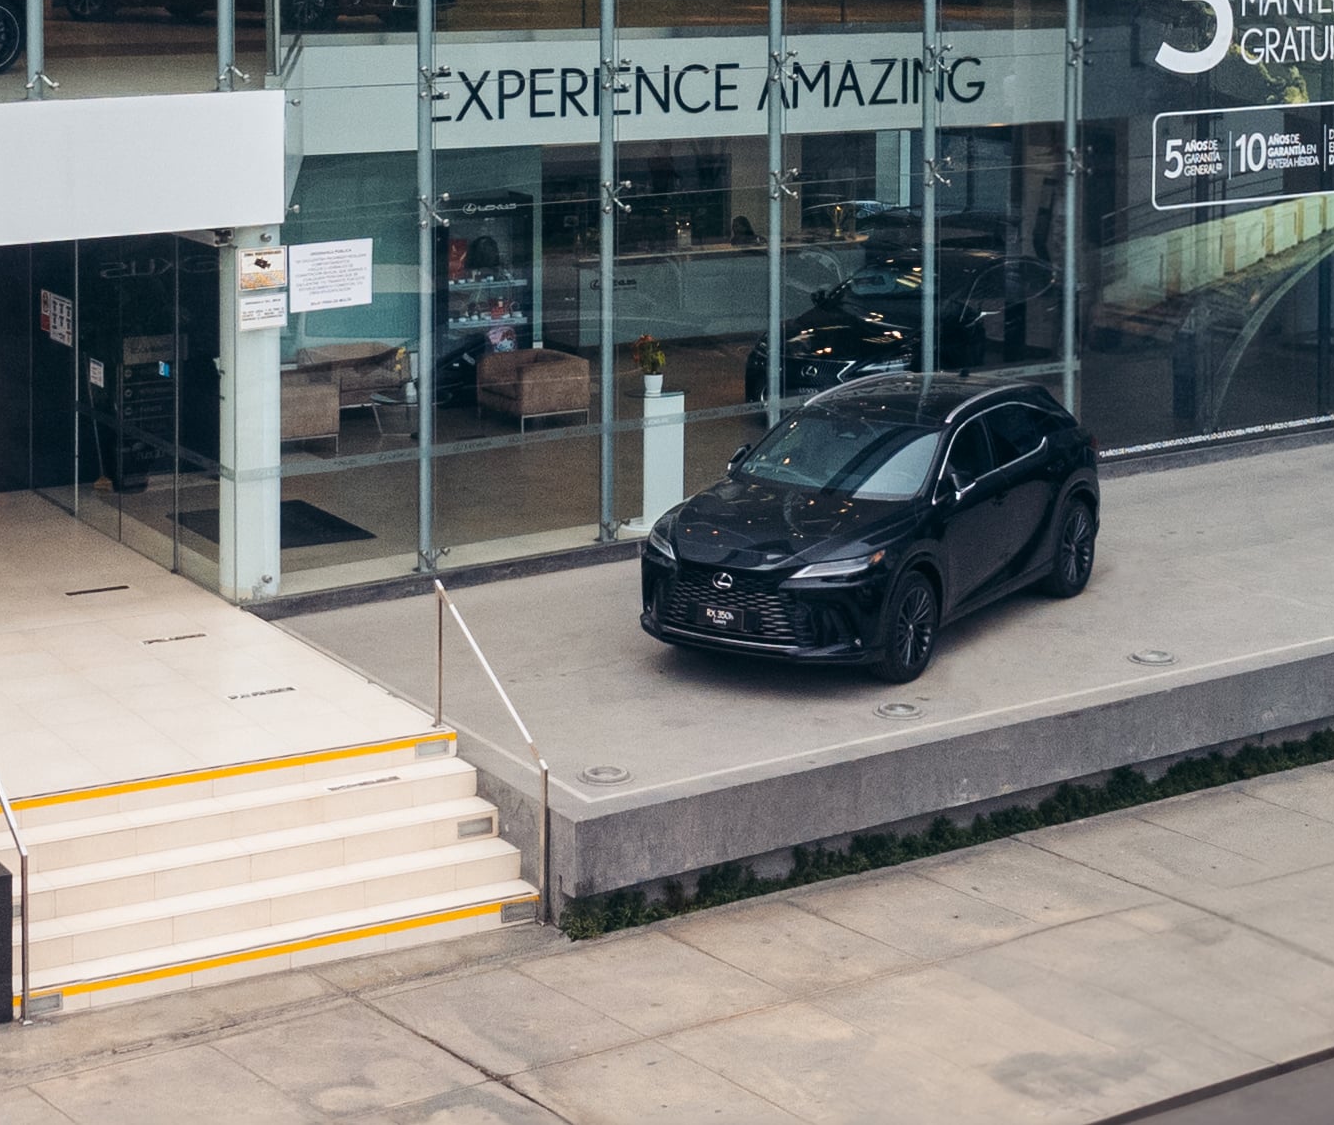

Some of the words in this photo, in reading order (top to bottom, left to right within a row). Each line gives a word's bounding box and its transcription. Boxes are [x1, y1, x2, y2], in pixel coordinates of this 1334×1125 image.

[757, 56, 985, 111] AMAZING
[1184, 139, 1208, 153] AÑOS
[1208, 139, 1219, 150] DE
[1268, 133, 1290, 146] AÑOS
[1290, 133, 1300, 144] DE
[1235, 132, 1267, 173] 10
[1268, 143, 1306, 158] GARANTÍA
[1164, 139, 1184, 179] 5
[706, 608, 716, 618] RX
